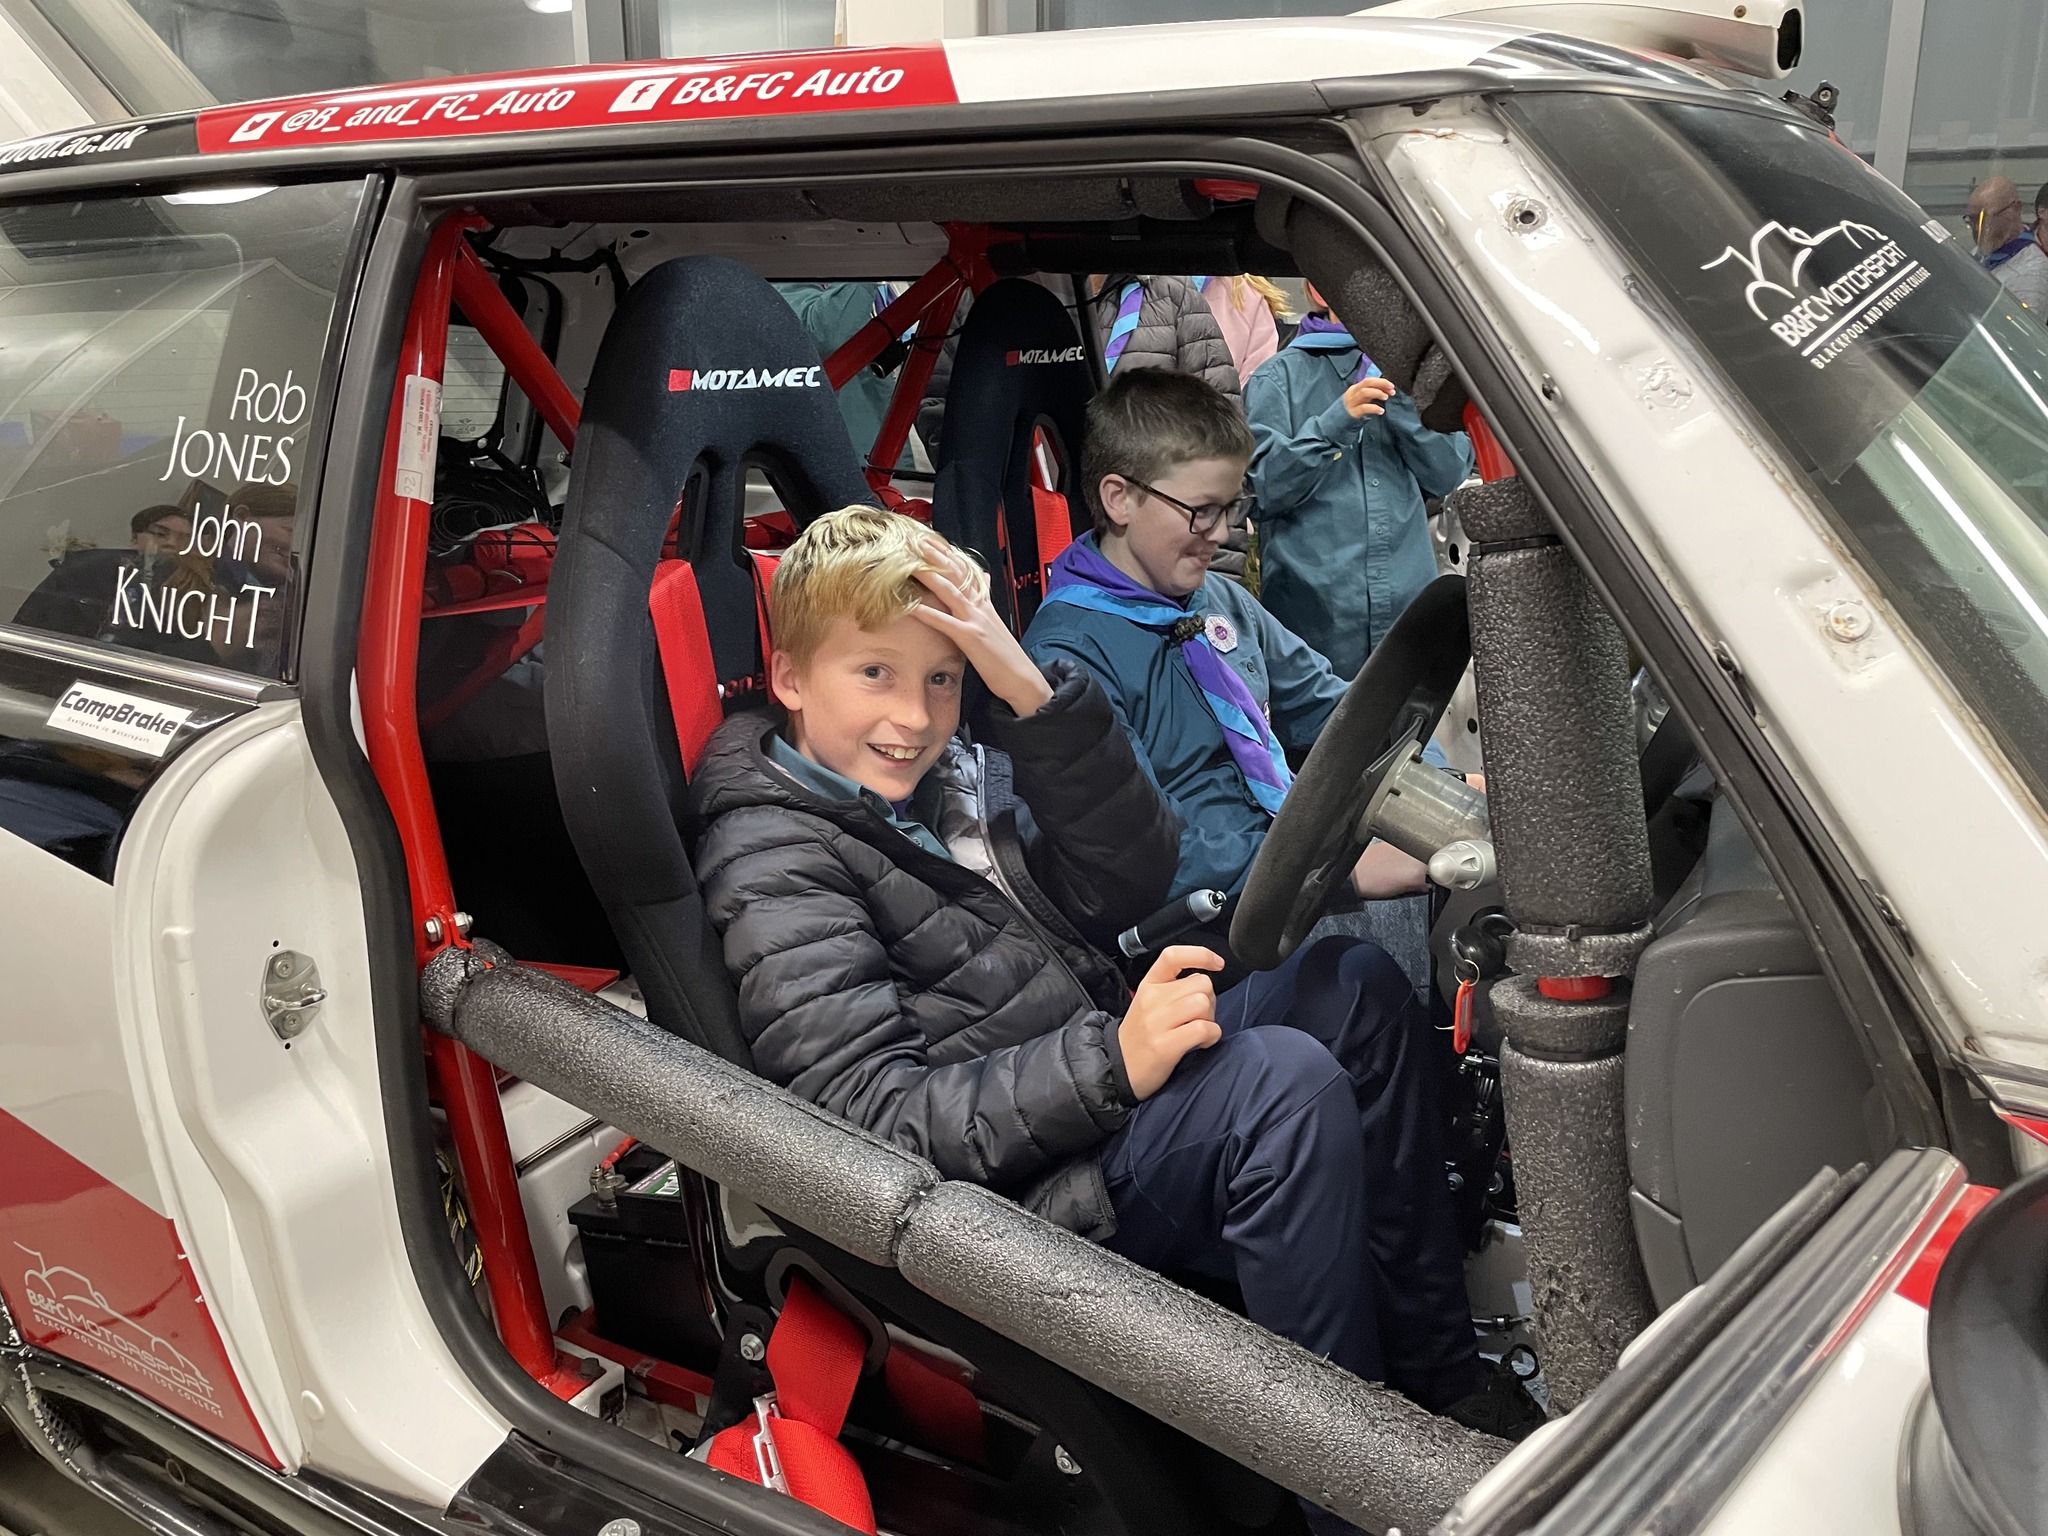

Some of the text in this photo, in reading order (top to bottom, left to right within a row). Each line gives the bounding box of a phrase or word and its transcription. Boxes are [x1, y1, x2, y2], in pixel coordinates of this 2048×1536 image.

[280, 87, 576, 133] @B_and_FC_Auto
[671, 71, 794, 105] B&FC
[791, 66, 905, 98] Auto
[1810, 266, 1931, 370] BLACKPOOL AND THE FYLDE COLLEGE
[690, 365, 821, 391] MOTAMEC
[1018, 346, 1084, 364] MOTAMEC
[229, 368, 306, 425] Rob
[159, 415, 294, 486] JONES
[178, 502, 262, 563] John
[111, 566, 276, 649] KNIGHT
[60, 690, 178, 736] CompBrake
[34, 1314, 94, 1347] BLACKPOOL
[97, 1343, 117, 1359] AND
[119, 1355, 139, 1372] THE
[177, 1388, 224, 1418] COLLEGE
